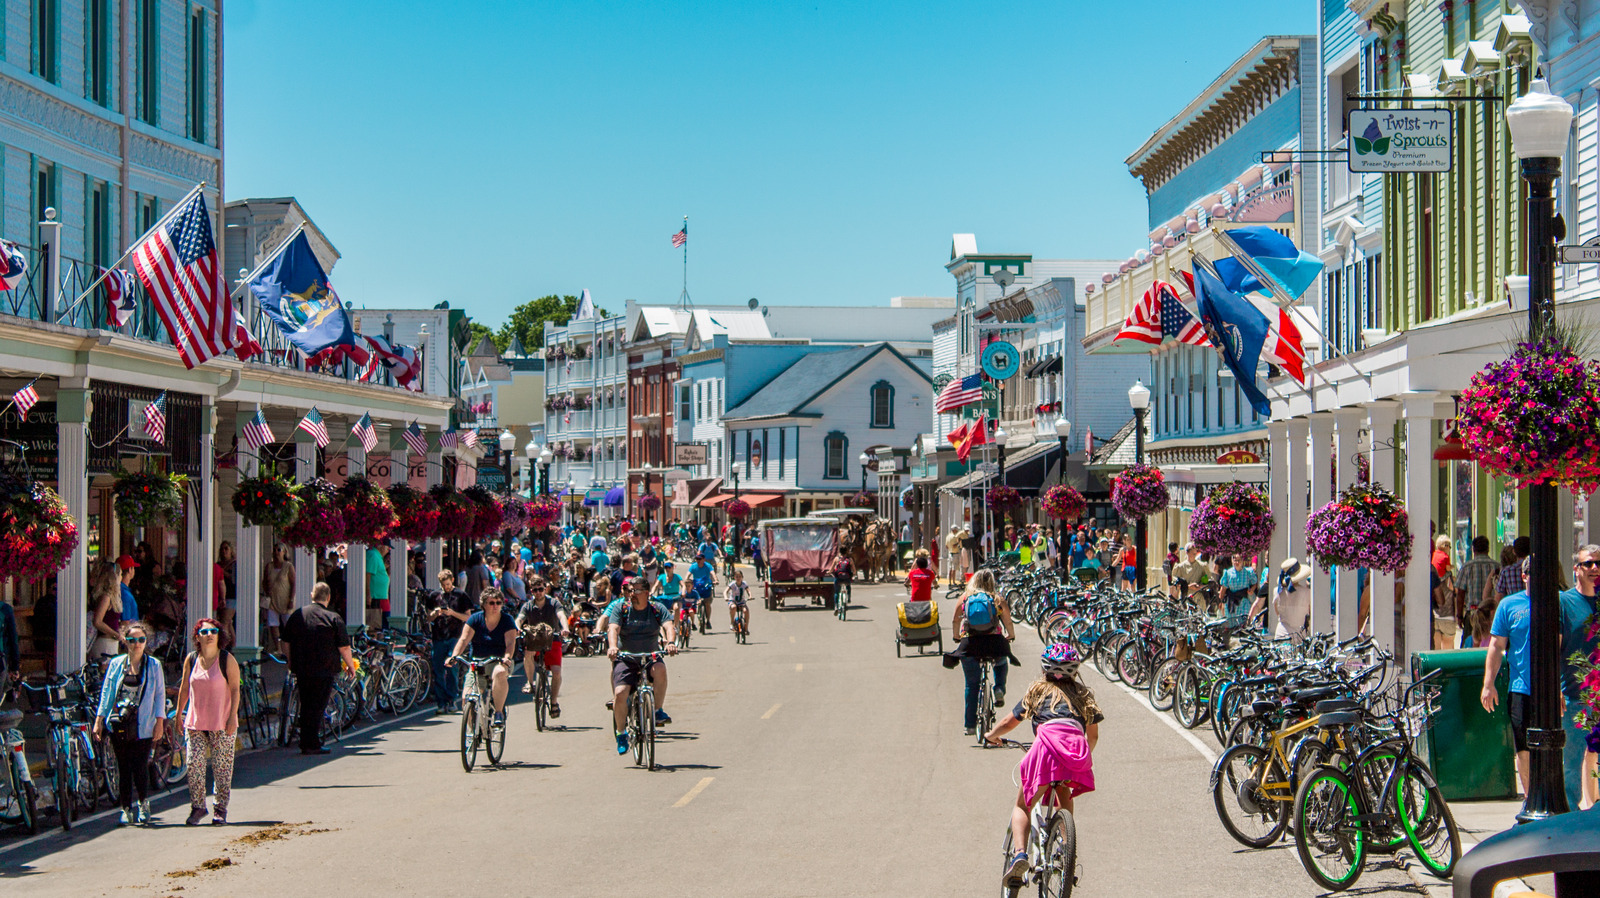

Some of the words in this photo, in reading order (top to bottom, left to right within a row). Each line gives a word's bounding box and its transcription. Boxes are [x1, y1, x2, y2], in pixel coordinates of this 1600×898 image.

[1383, 114, 1420, 131] Twist
[1391, 132, 1447, 150] Sprouts
[1392, 151, 1426, 159] Premium
[1383, 160, 1404, 168] Yogurt
[32, 440, 58, 451] Welc
